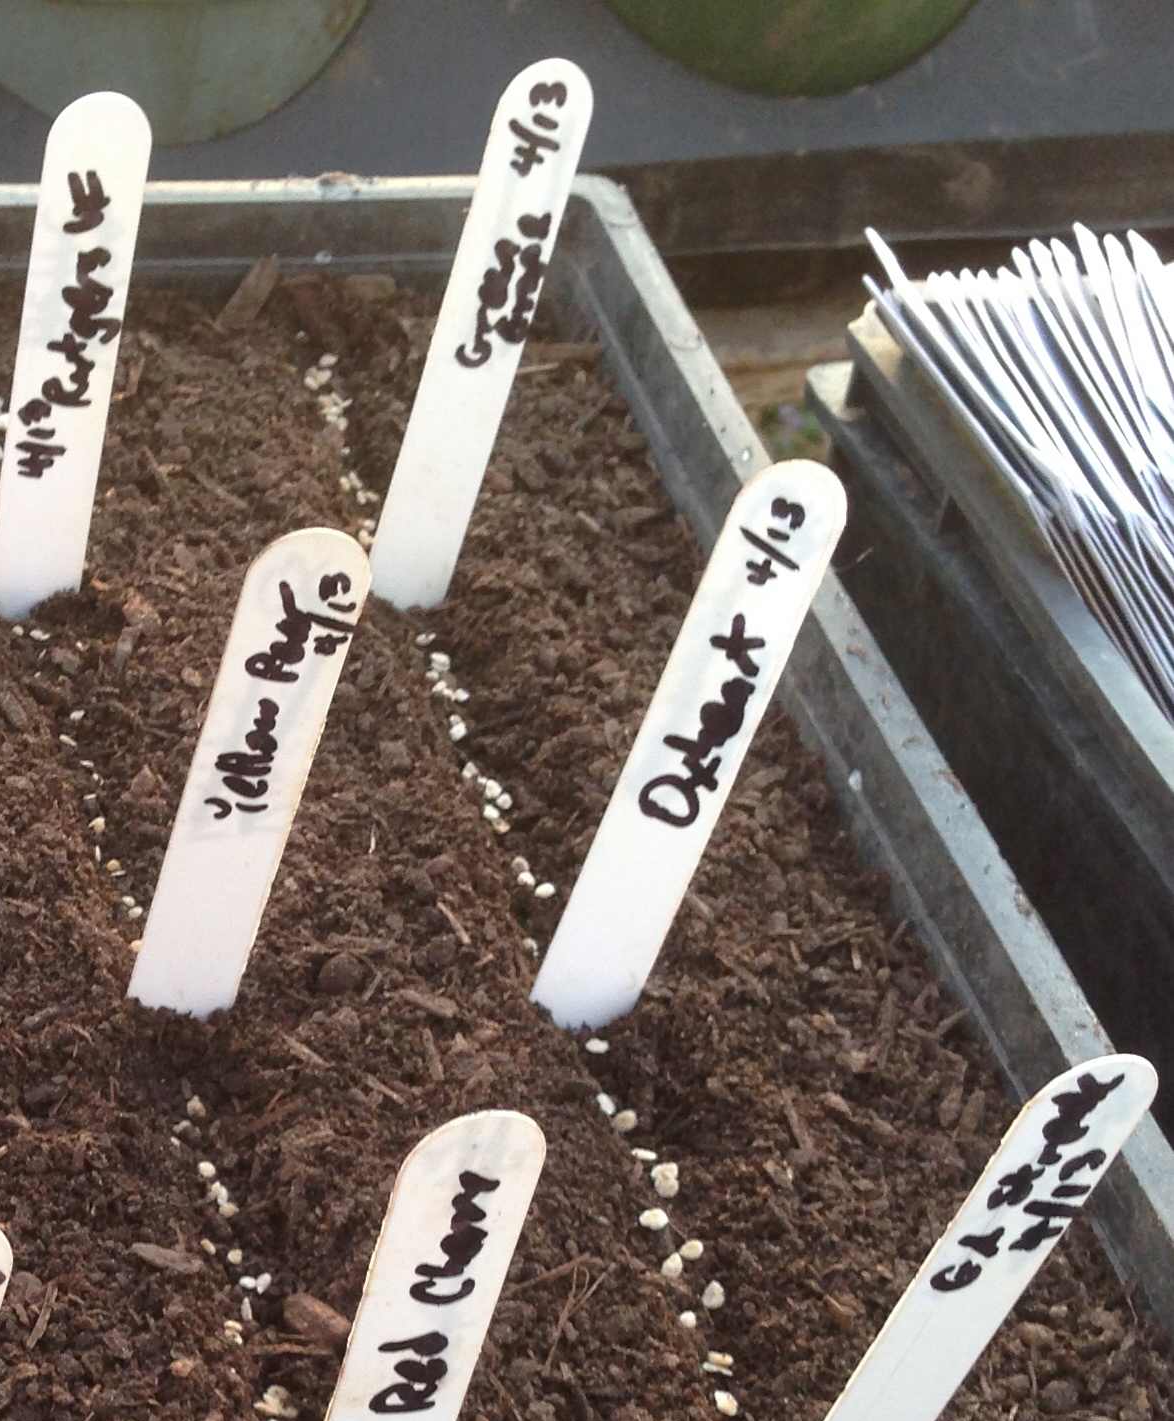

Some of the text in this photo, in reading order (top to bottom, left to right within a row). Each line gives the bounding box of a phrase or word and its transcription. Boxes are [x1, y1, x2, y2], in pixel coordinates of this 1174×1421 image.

[509, 81, 567, 178] 4/13
[16, 398, 66, 479] 4/13
[41, 247, 123, 407] Rutgers
[740, 497, 806, 585] 4/13
[307, 572, 358, 656] 4/13
[1008, 1148, 1107, 1252] 4/13
[368, 1331, 449, 1414] Red
